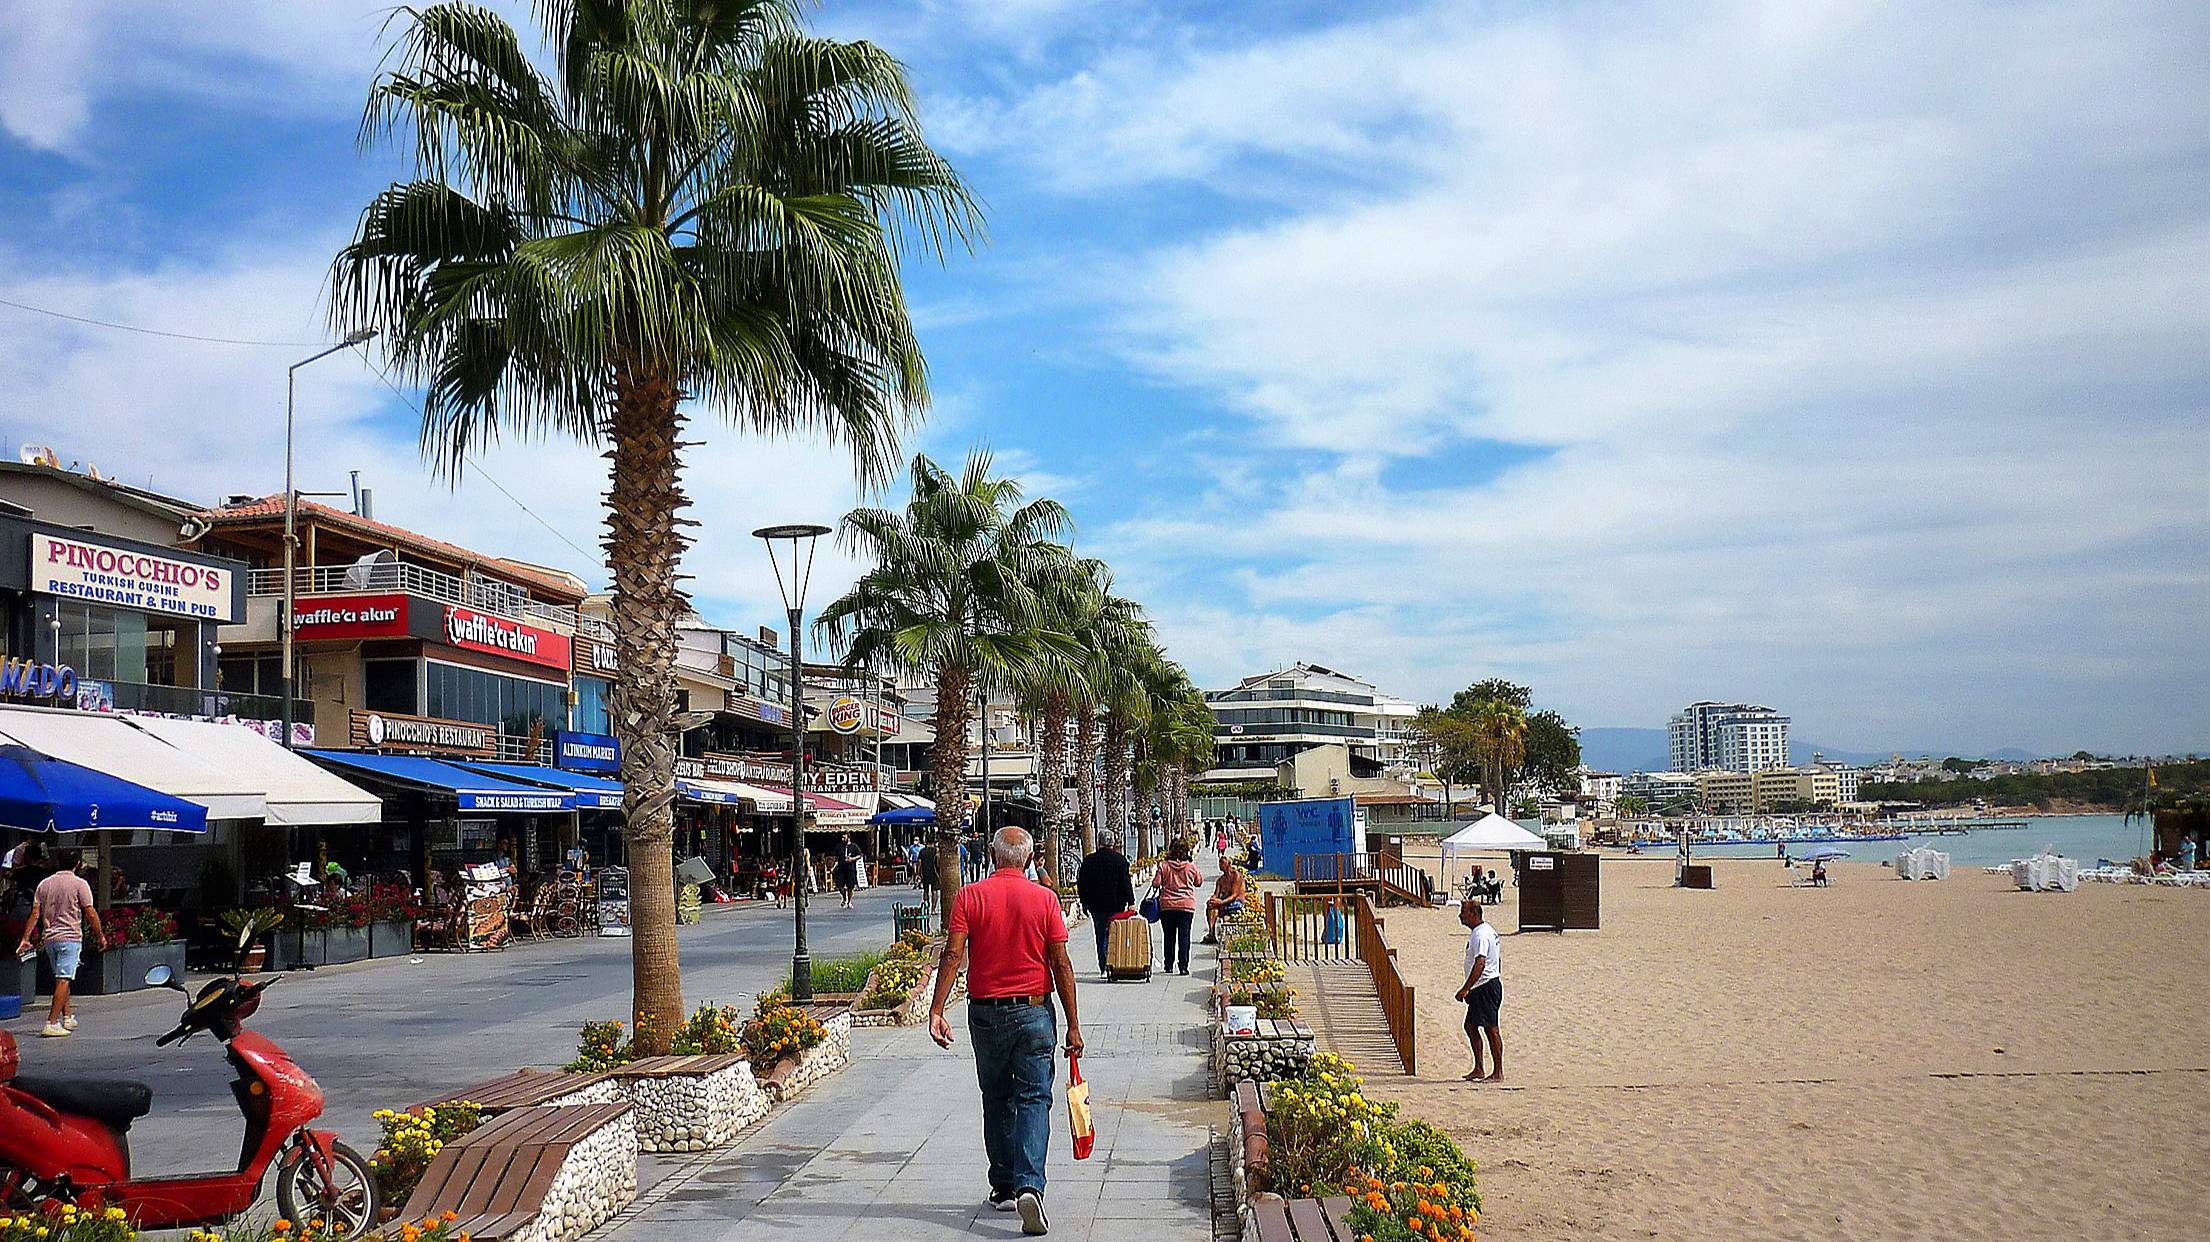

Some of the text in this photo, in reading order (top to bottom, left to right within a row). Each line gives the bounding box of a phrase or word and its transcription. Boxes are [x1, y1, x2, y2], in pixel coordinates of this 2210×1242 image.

[48, 540, 220, 591] PINOCCHIO'S
[83, 571, 179, 600] TURKISH CUSINE
[48, 579, 217, 617] RESTAURANT & FUN PUB
[0, 655, 77, 701] MADO
[832, 703, 860, 716] BURGER
[832, 709, 861, 724] KING
[386, 720, 486, 749] PINOCCHIO'S RESTAURANT
[593, 746, 615, 761] MARKET
[826, 772, 871, 785] EDEN
[841, 784, 849, 793] &
[853, 784, 873, 792] BAR
[475, 796, 495, 808] SNACK
